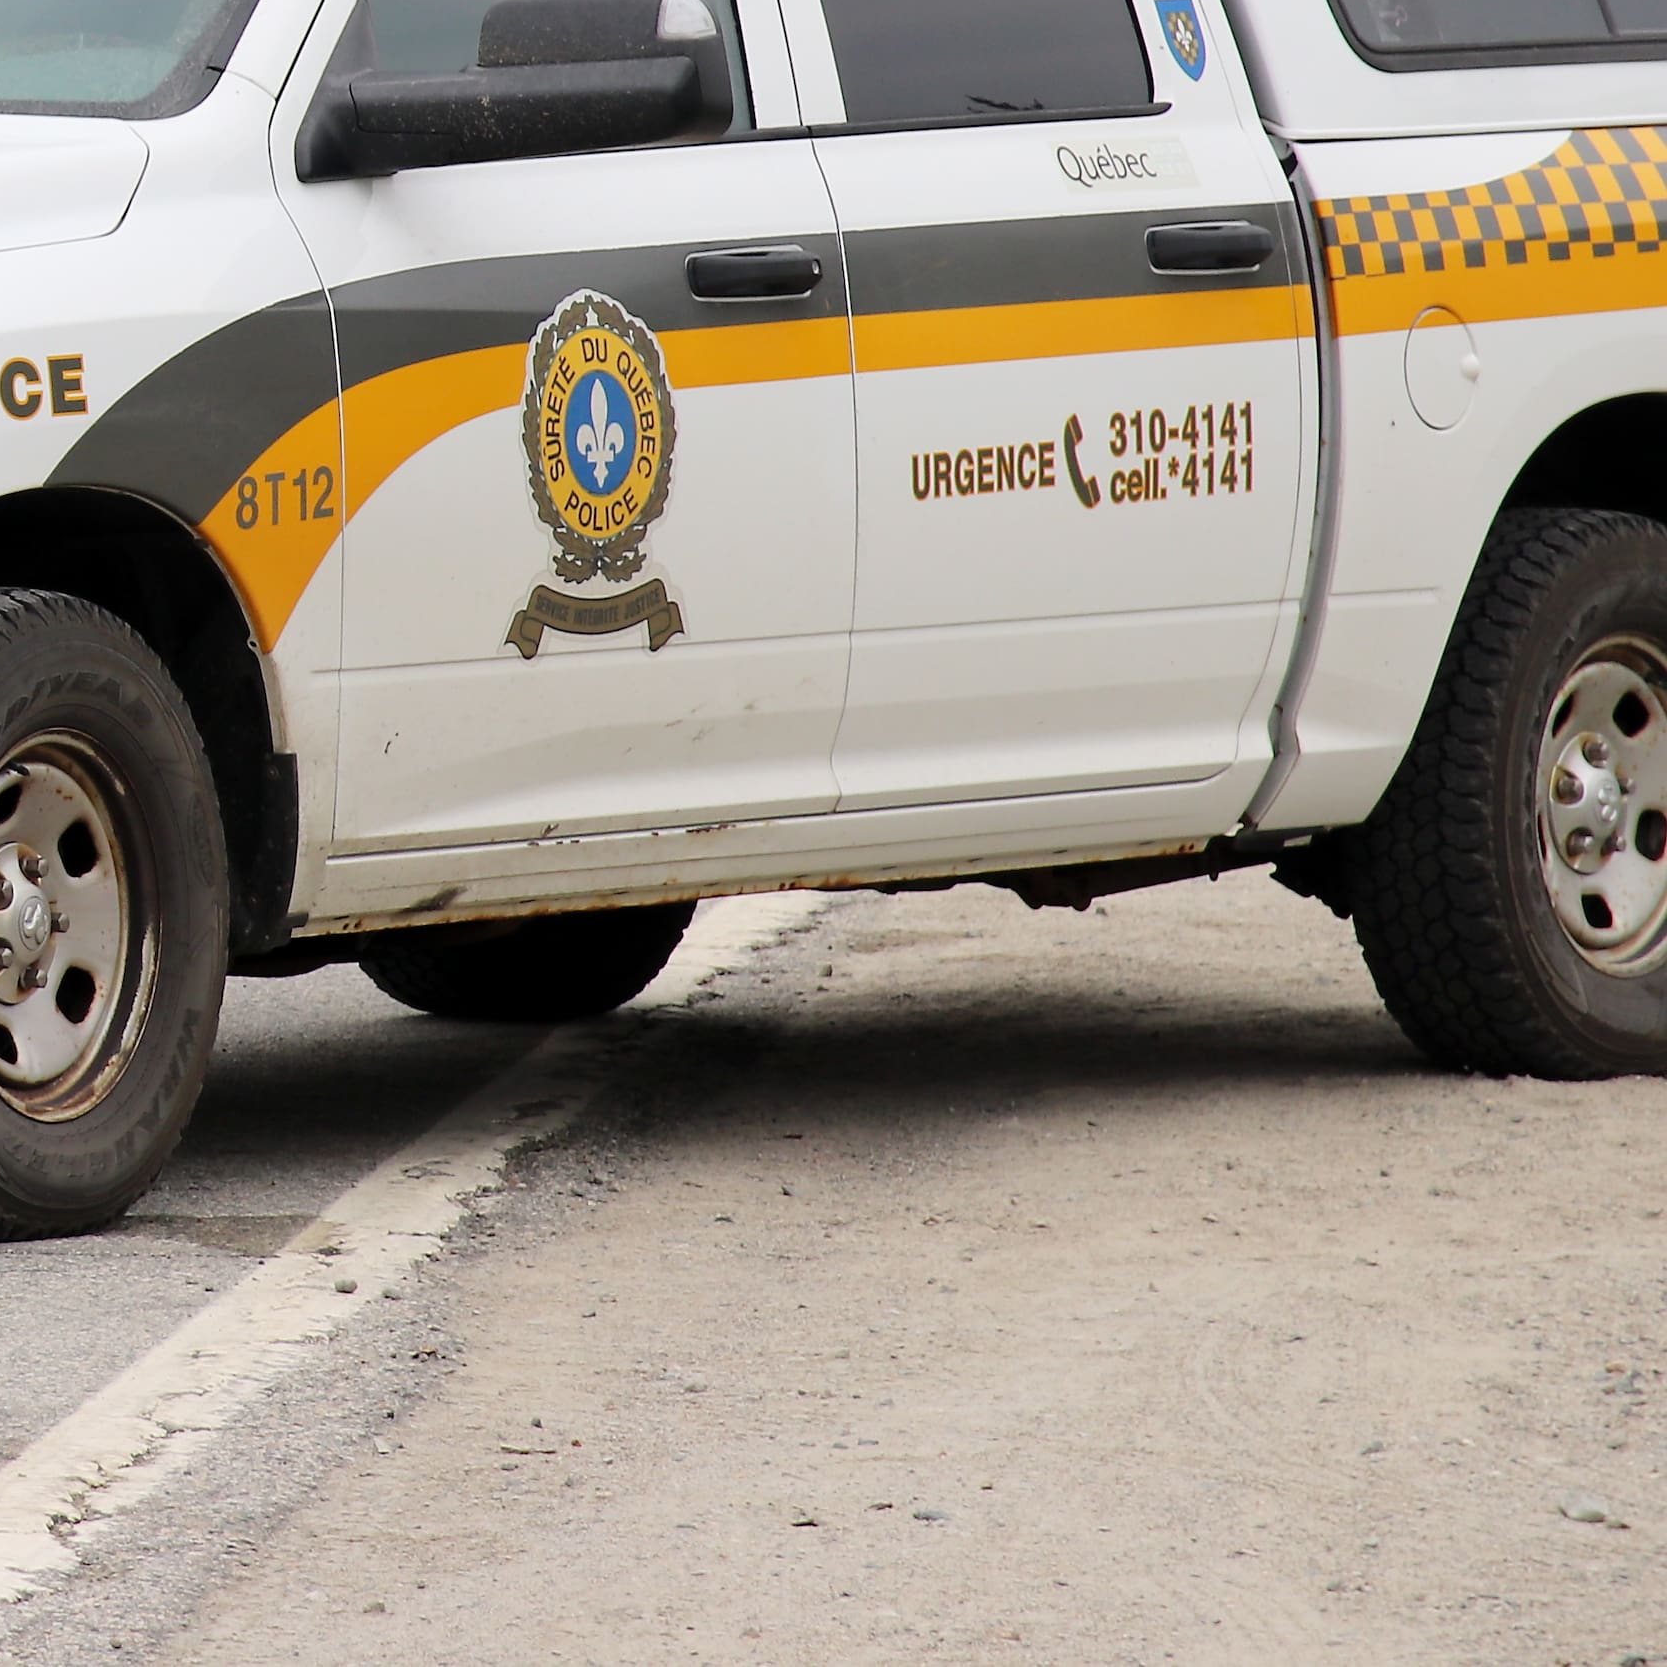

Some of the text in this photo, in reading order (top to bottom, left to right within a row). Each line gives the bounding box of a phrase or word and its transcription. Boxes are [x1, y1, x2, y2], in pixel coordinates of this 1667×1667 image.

[1056, 143, 1158, 188] Québec
[543, 336, 656, 483] SÛRETÉ DU QUÉBEC
[1109, 400, 1253, 458] 310-4141
[235, 465, 335, 530] 8T12
[911, 440, 1056, 501] URGENCE
[564, 486, 639, 532] POLICE
[535, 594, 570, 622] SERVICE
[623, 588, 661, 620] JUSTICE
